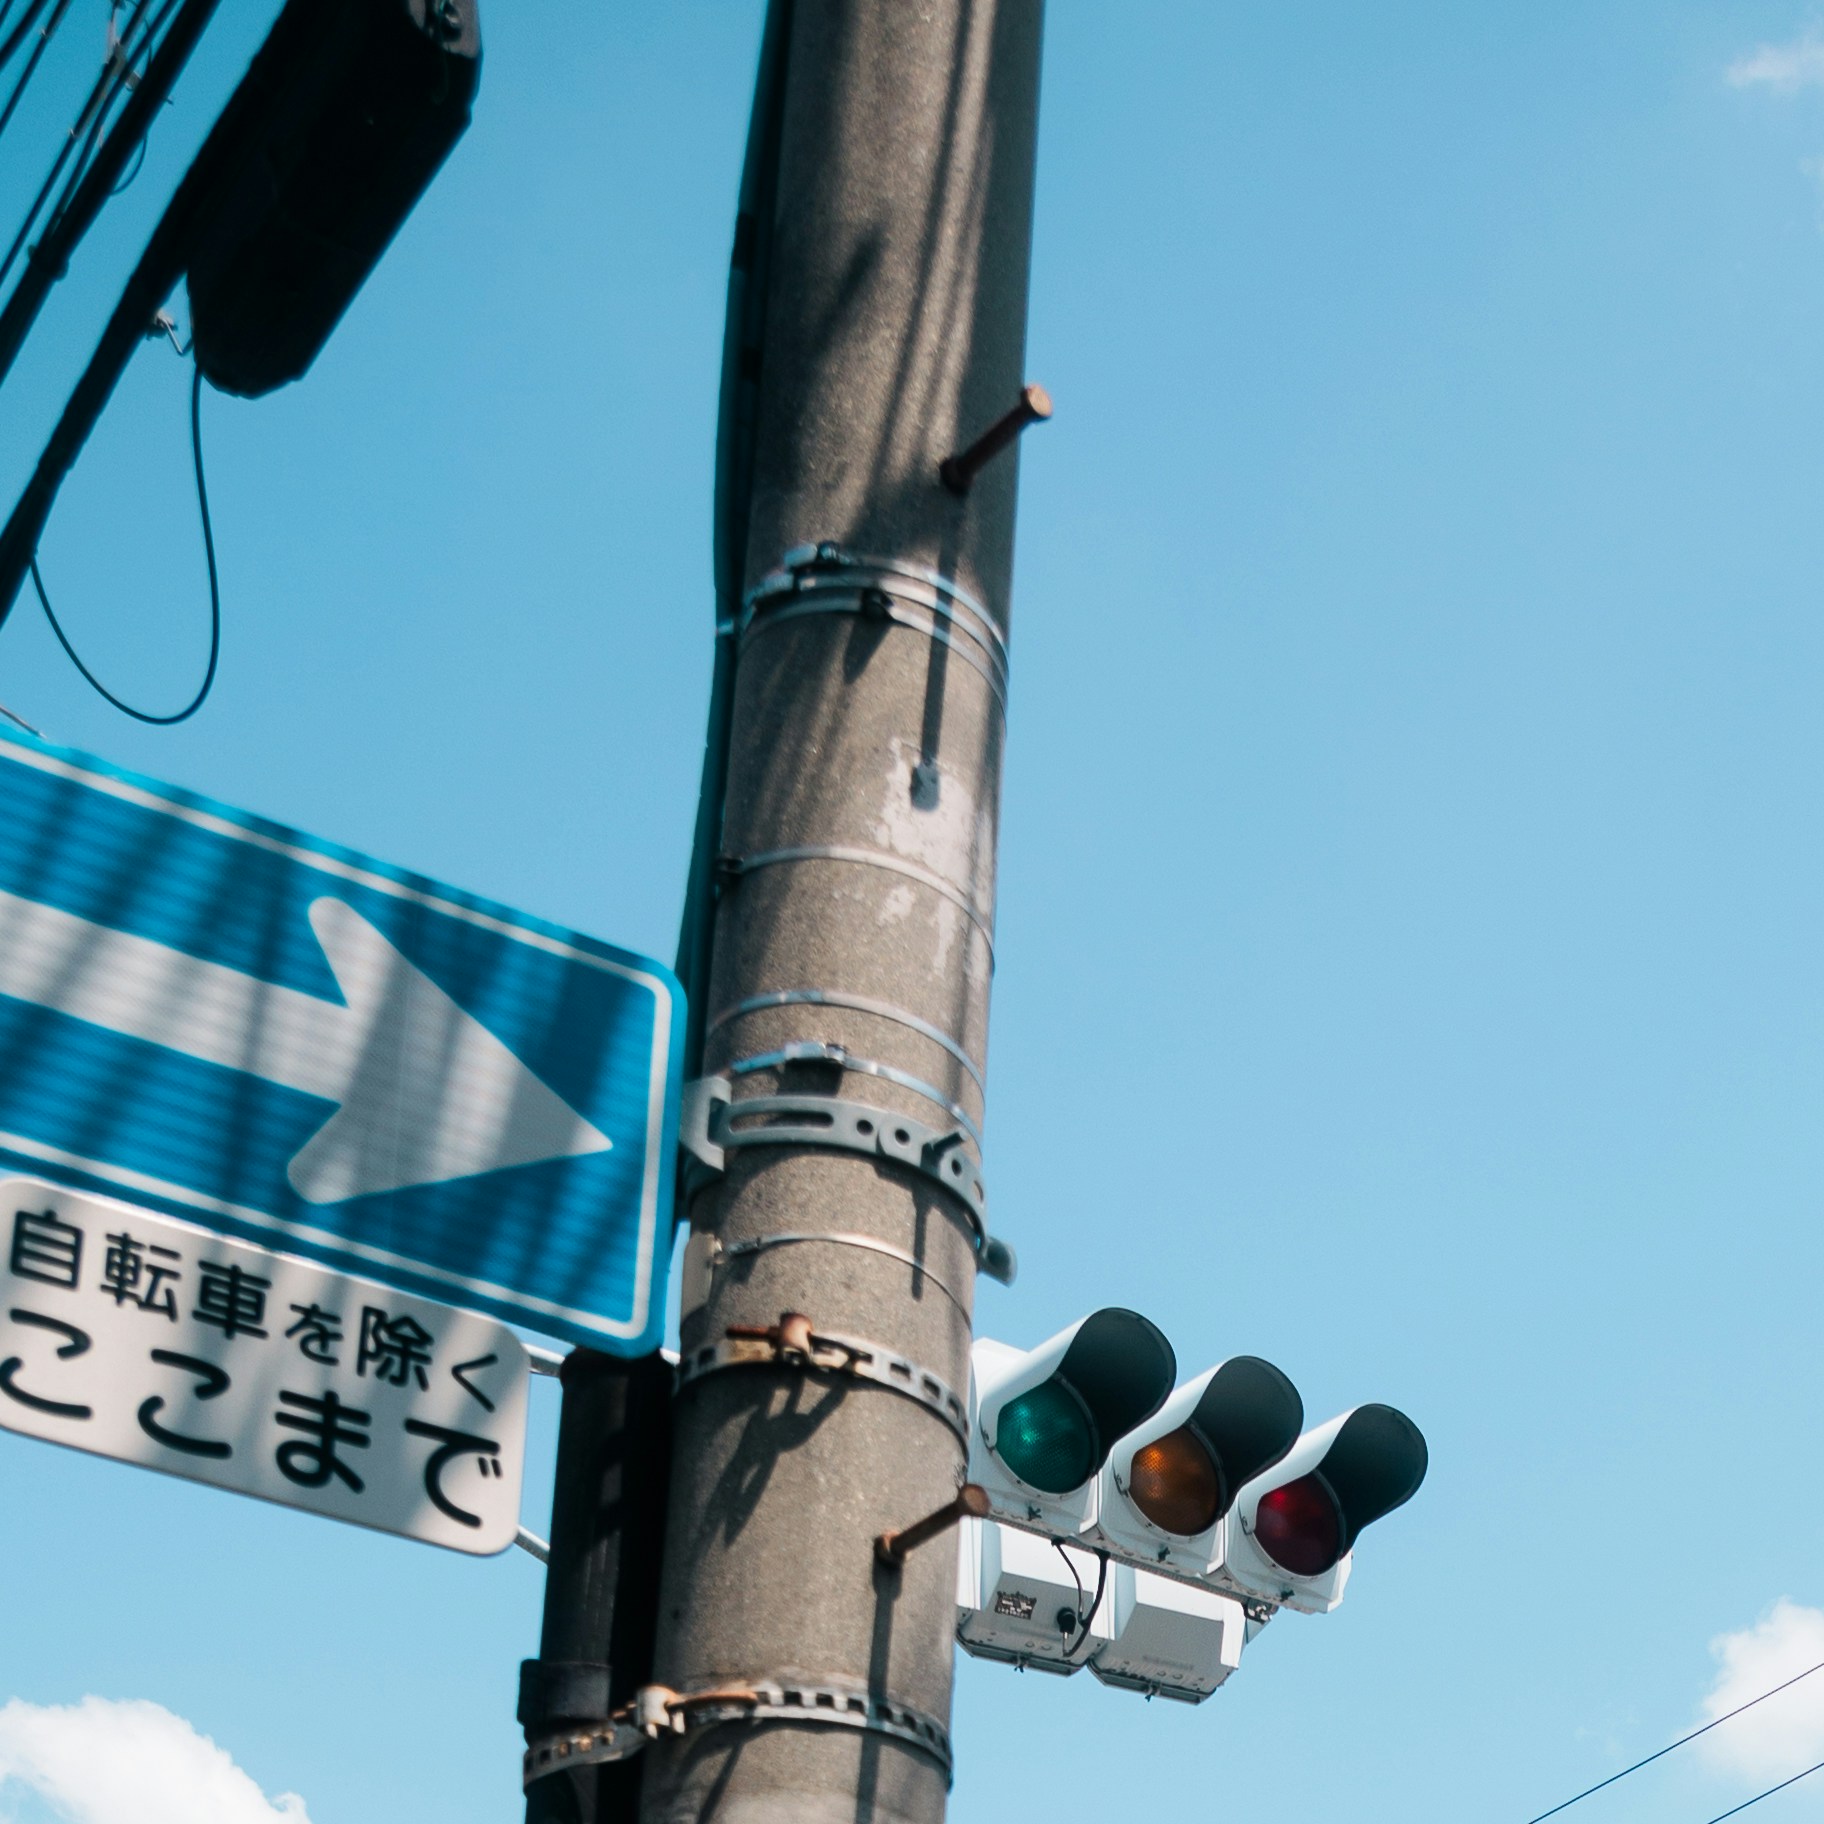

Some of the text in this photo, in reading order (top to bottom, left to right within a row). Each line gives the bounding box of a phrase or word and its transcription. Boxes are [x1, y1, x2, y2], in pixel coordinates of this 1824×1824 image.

[0, 1307, 504, 1530] ここまで
[8, 1207, 500, 1415] 自転車を除く
